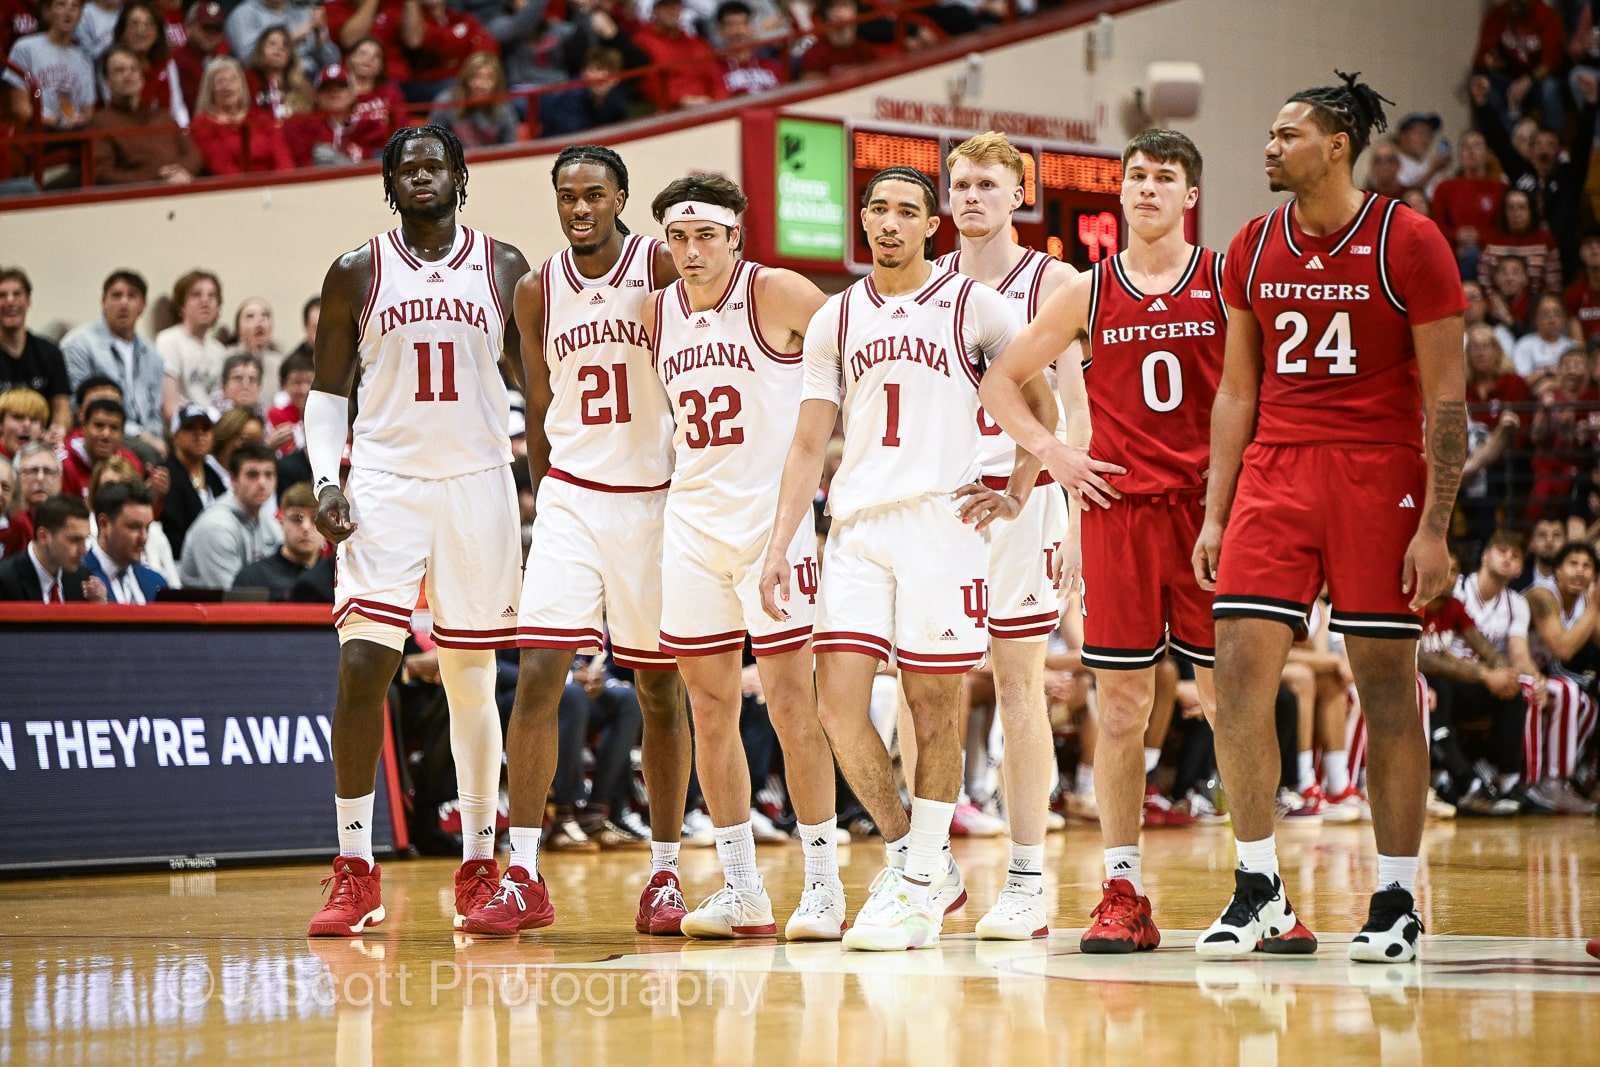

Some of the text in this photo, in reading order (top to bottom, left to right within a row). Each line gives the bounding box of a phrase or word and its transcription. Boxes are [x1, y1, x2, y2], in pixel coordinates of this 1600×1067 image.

[379, 298, 489, 336] INDIANA
[1260, 283, 1370, 300] RUTGERS
[553, 319, 653, 361] INDIANA
[850, 335, 951, 382] INDIANA
[1102, 321, 1216, 344] RUTGERS
[1274, 311, 1357, 375] 24
[413, 342, 459, 401] 11
[663, 342, 755, 385] INDIANA
[1141, 350, 1184, 413] 0
[577, 363, 631, 425] 21
[679, 385, 745, 449] 32
[882, 383, 901, 447] 1
[26, 715, 210, 770] THEY'RE
